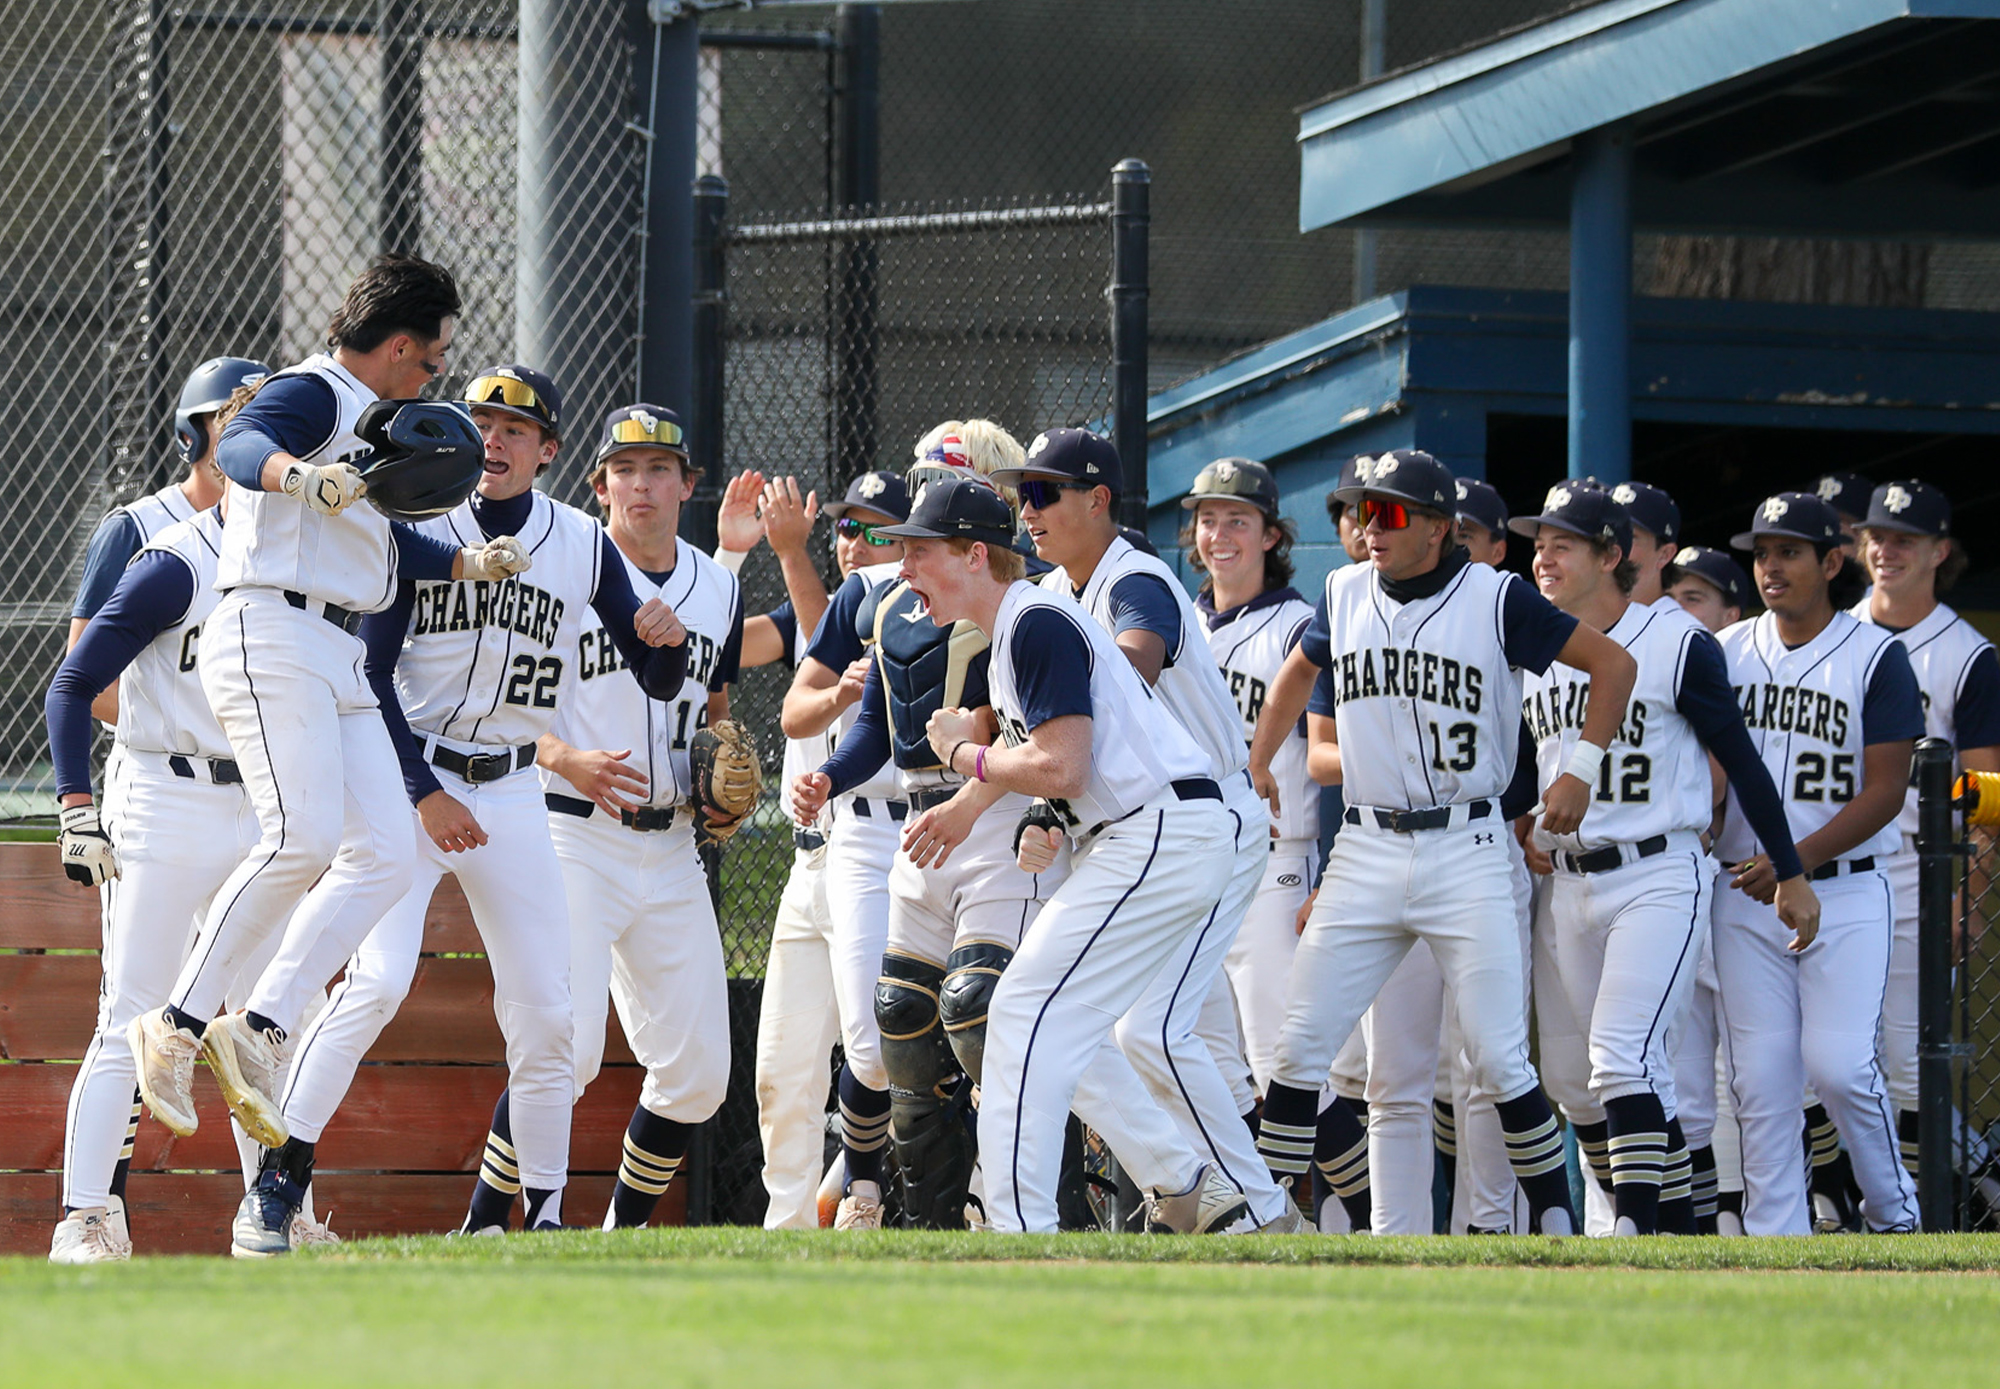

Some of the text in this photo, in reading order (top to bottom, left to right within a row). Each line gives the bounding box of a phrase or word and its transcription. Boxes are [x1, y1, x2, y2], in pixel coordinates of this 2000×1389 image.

[413, 578, 565, 651] CHARGERS
[504, 653, 564, 710] 22
[1429, 722, 1478, 772] 13
[1595, 752, 1653, 804] 12
[1793, 752, 1856, 803] 25
